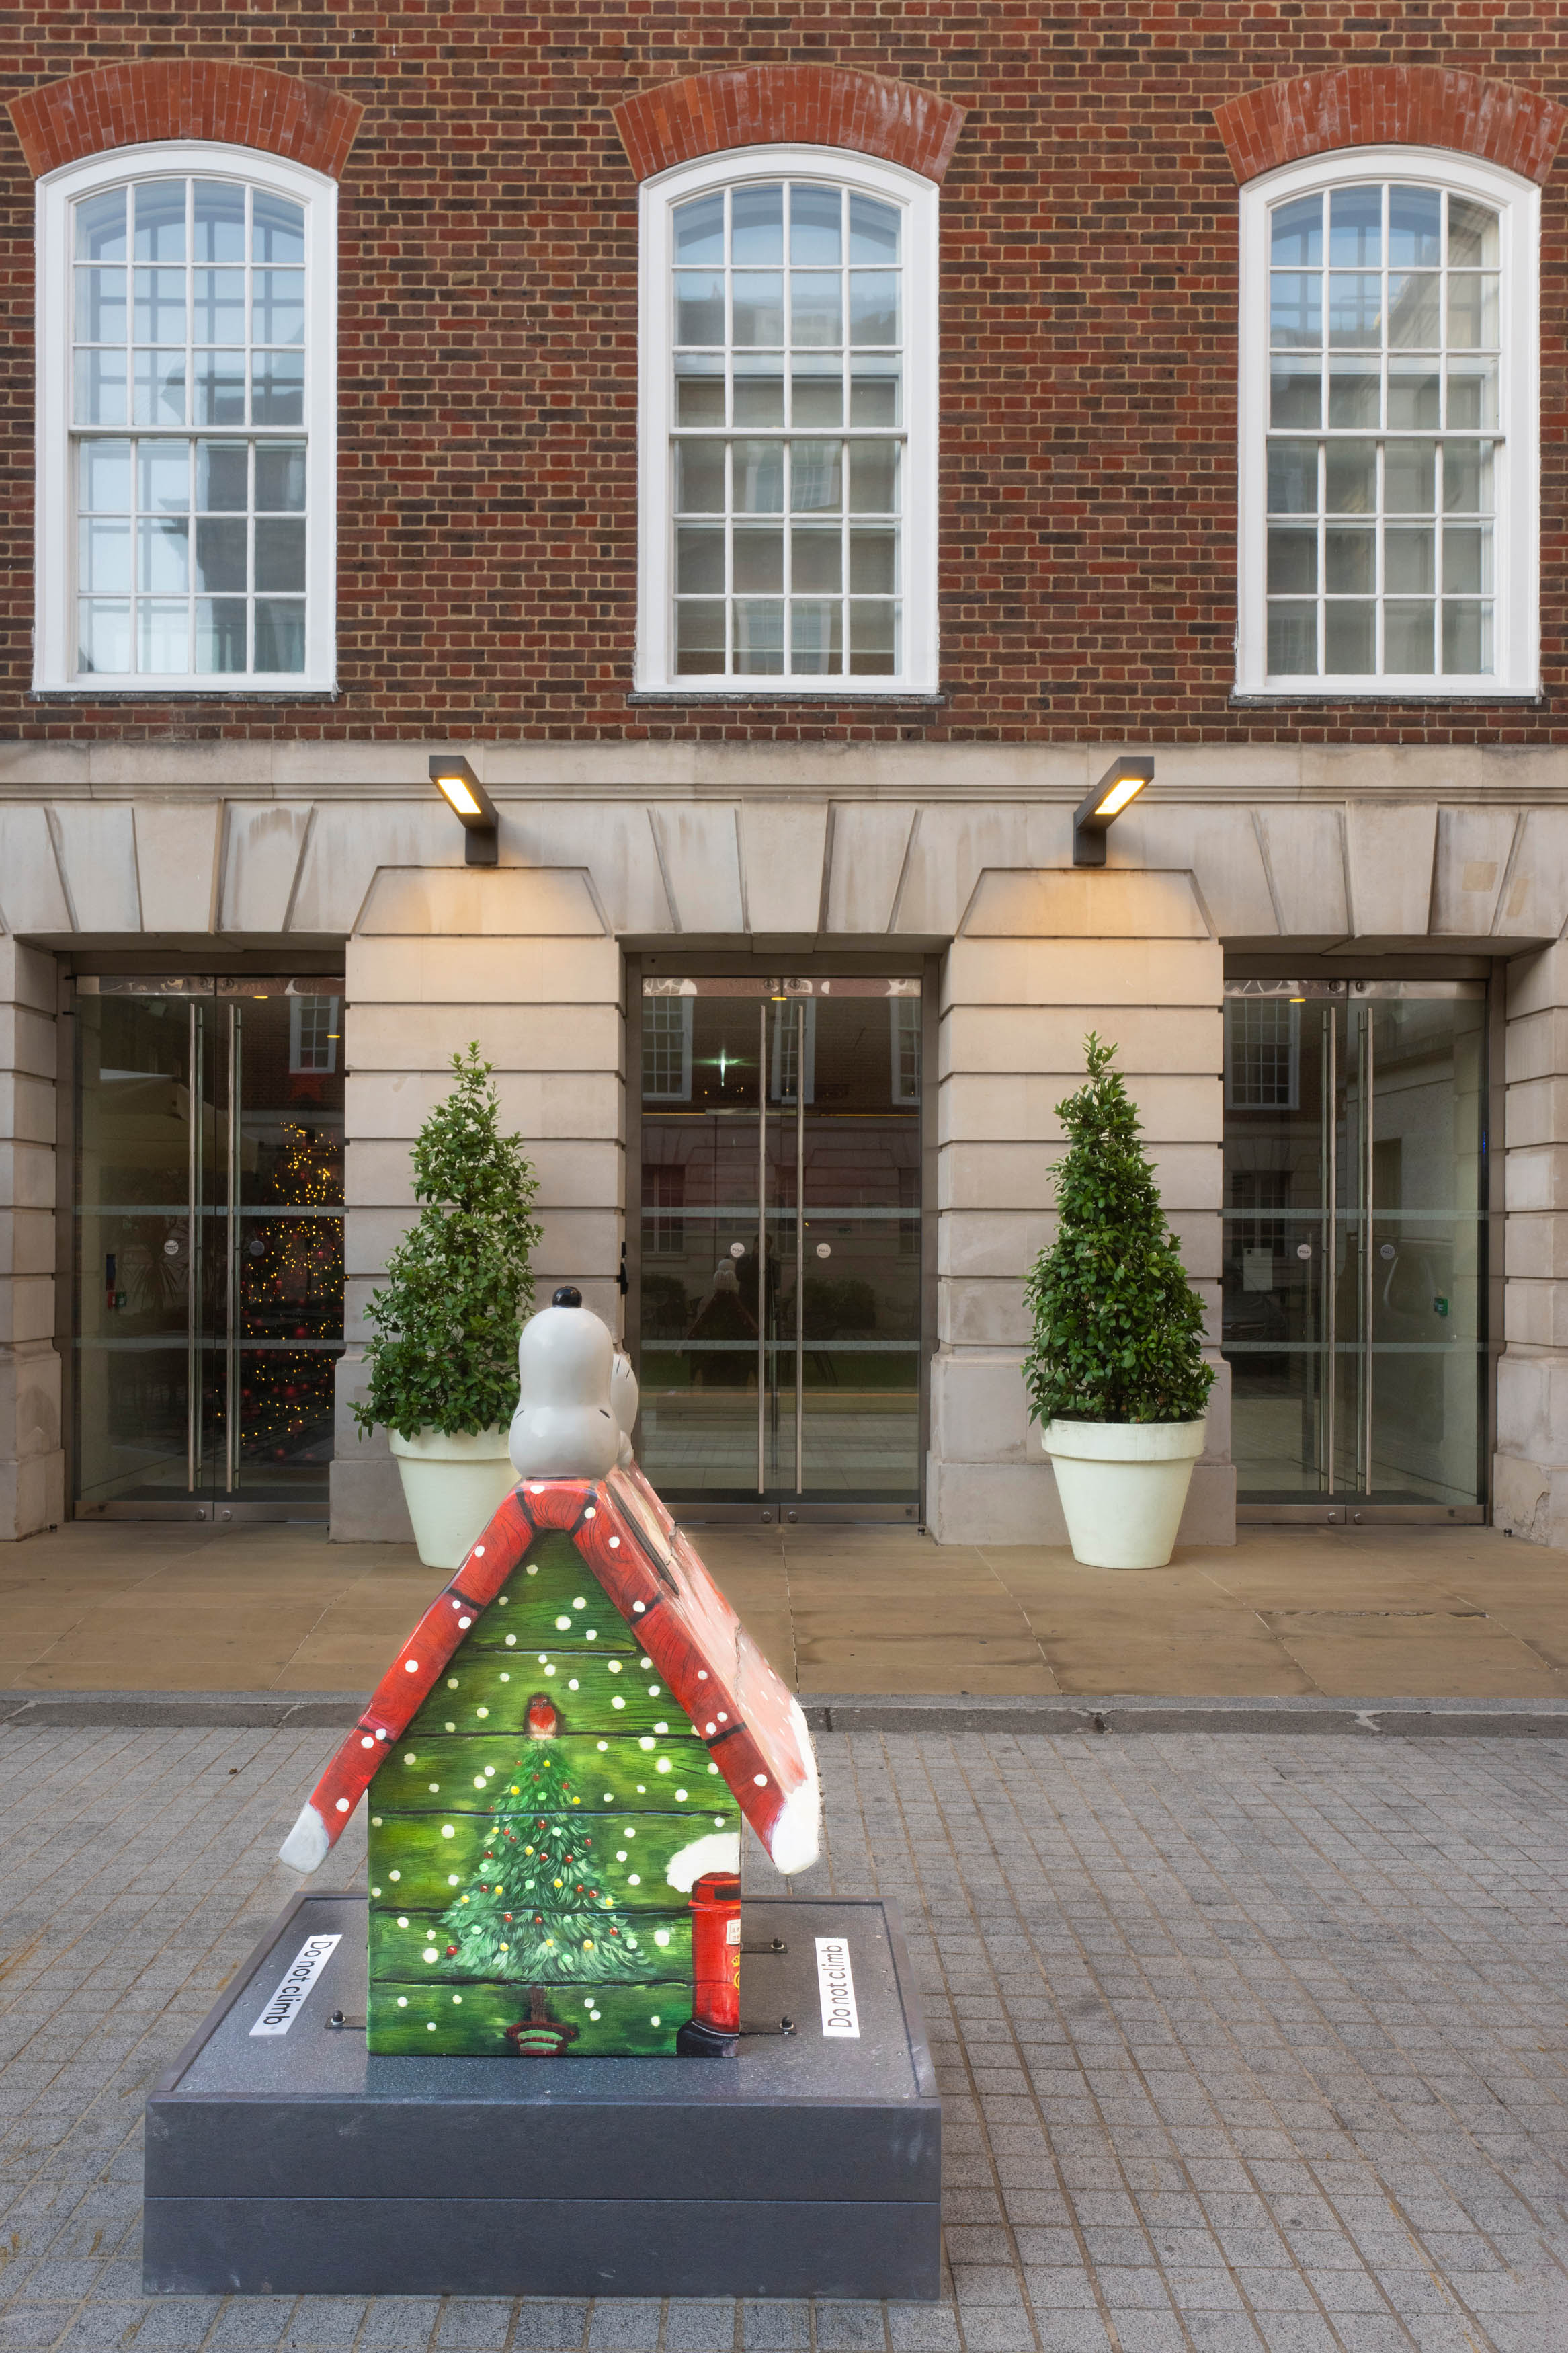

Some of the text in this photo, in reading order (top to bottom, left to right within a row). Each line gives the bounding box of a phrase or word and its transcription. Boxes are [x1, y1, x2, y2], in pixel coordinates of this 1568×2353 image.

[263, 1941, 333, 2025] Do not climb
[821, 1944, 852, 2028] Do not climb
